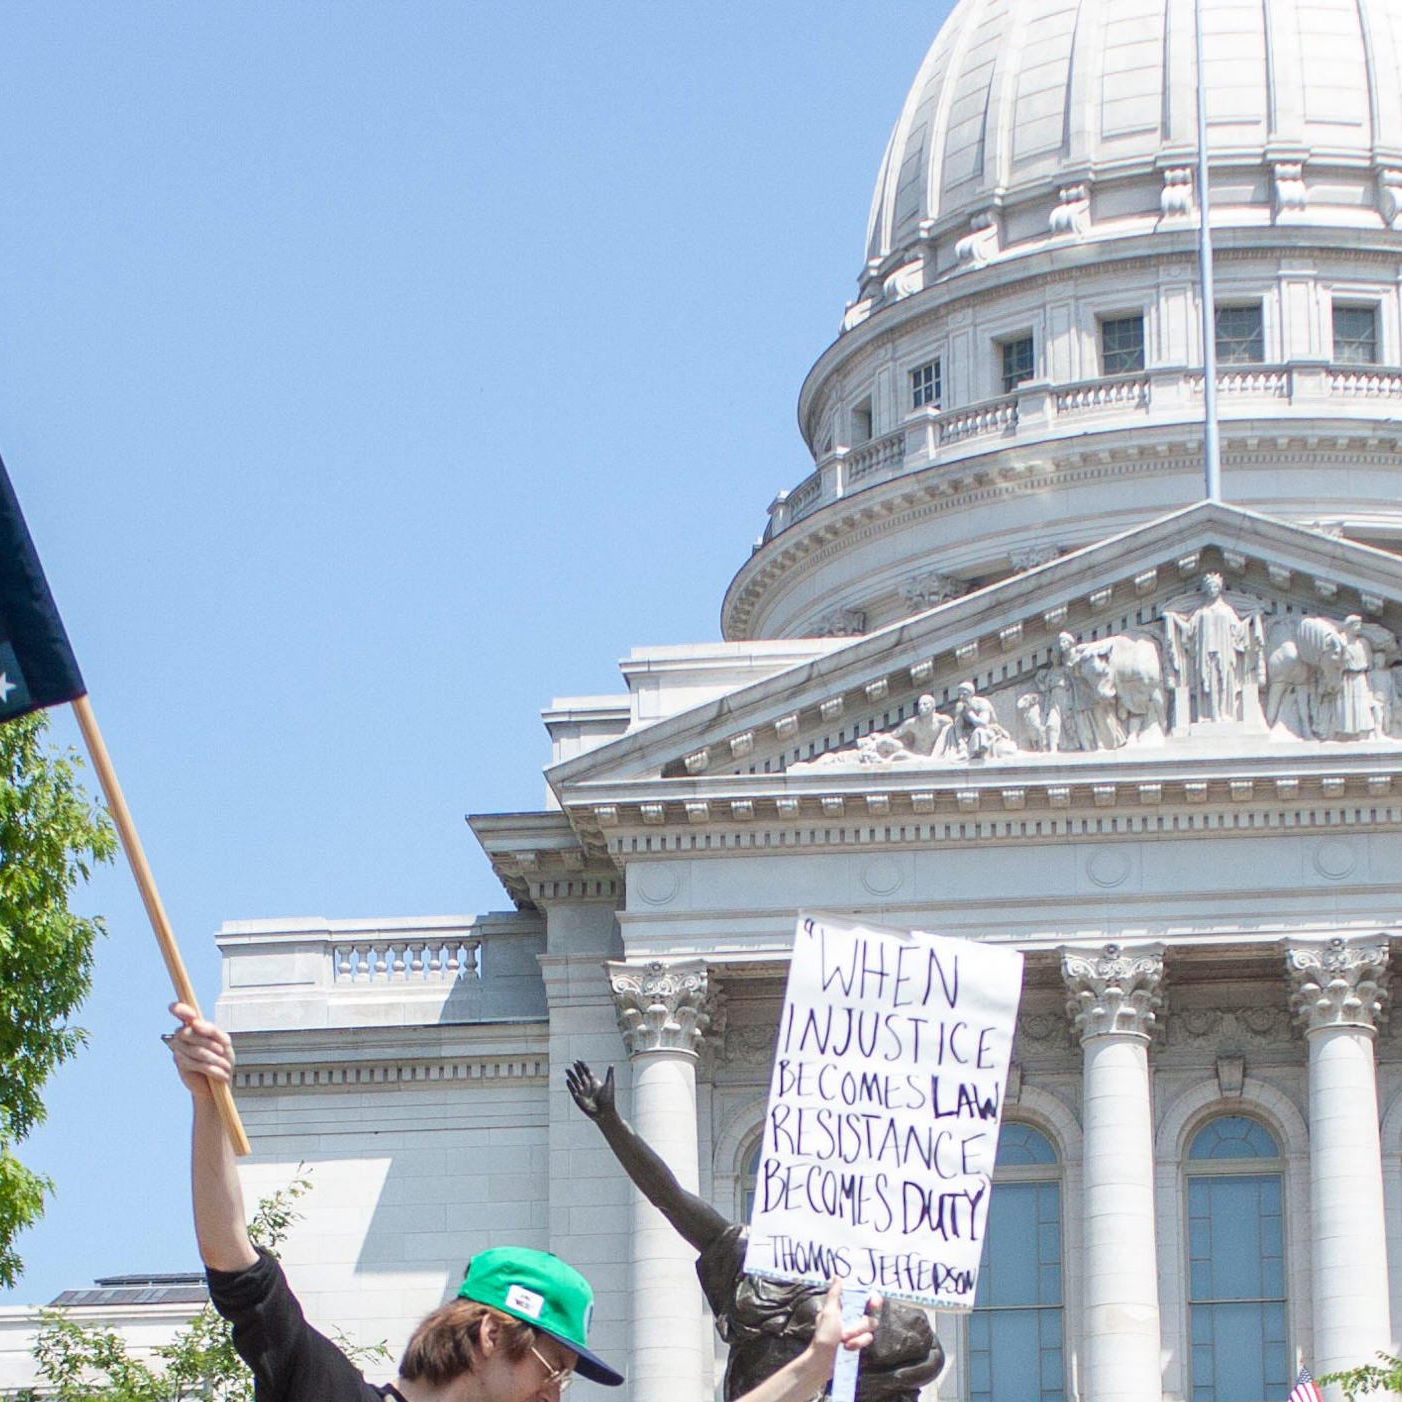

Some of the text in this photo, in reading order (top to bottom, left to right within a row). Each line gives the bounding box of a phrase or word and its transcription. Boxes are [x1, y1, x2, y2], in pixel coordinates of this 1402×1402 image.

[785, 1003, 997, 1070] INJUSTICE
[779, 1059, 926, 1109] BECOMES
[761, 1157, 893, 1233] BECOMES
[857, 1246, 975, 1294] JEFFERSON
